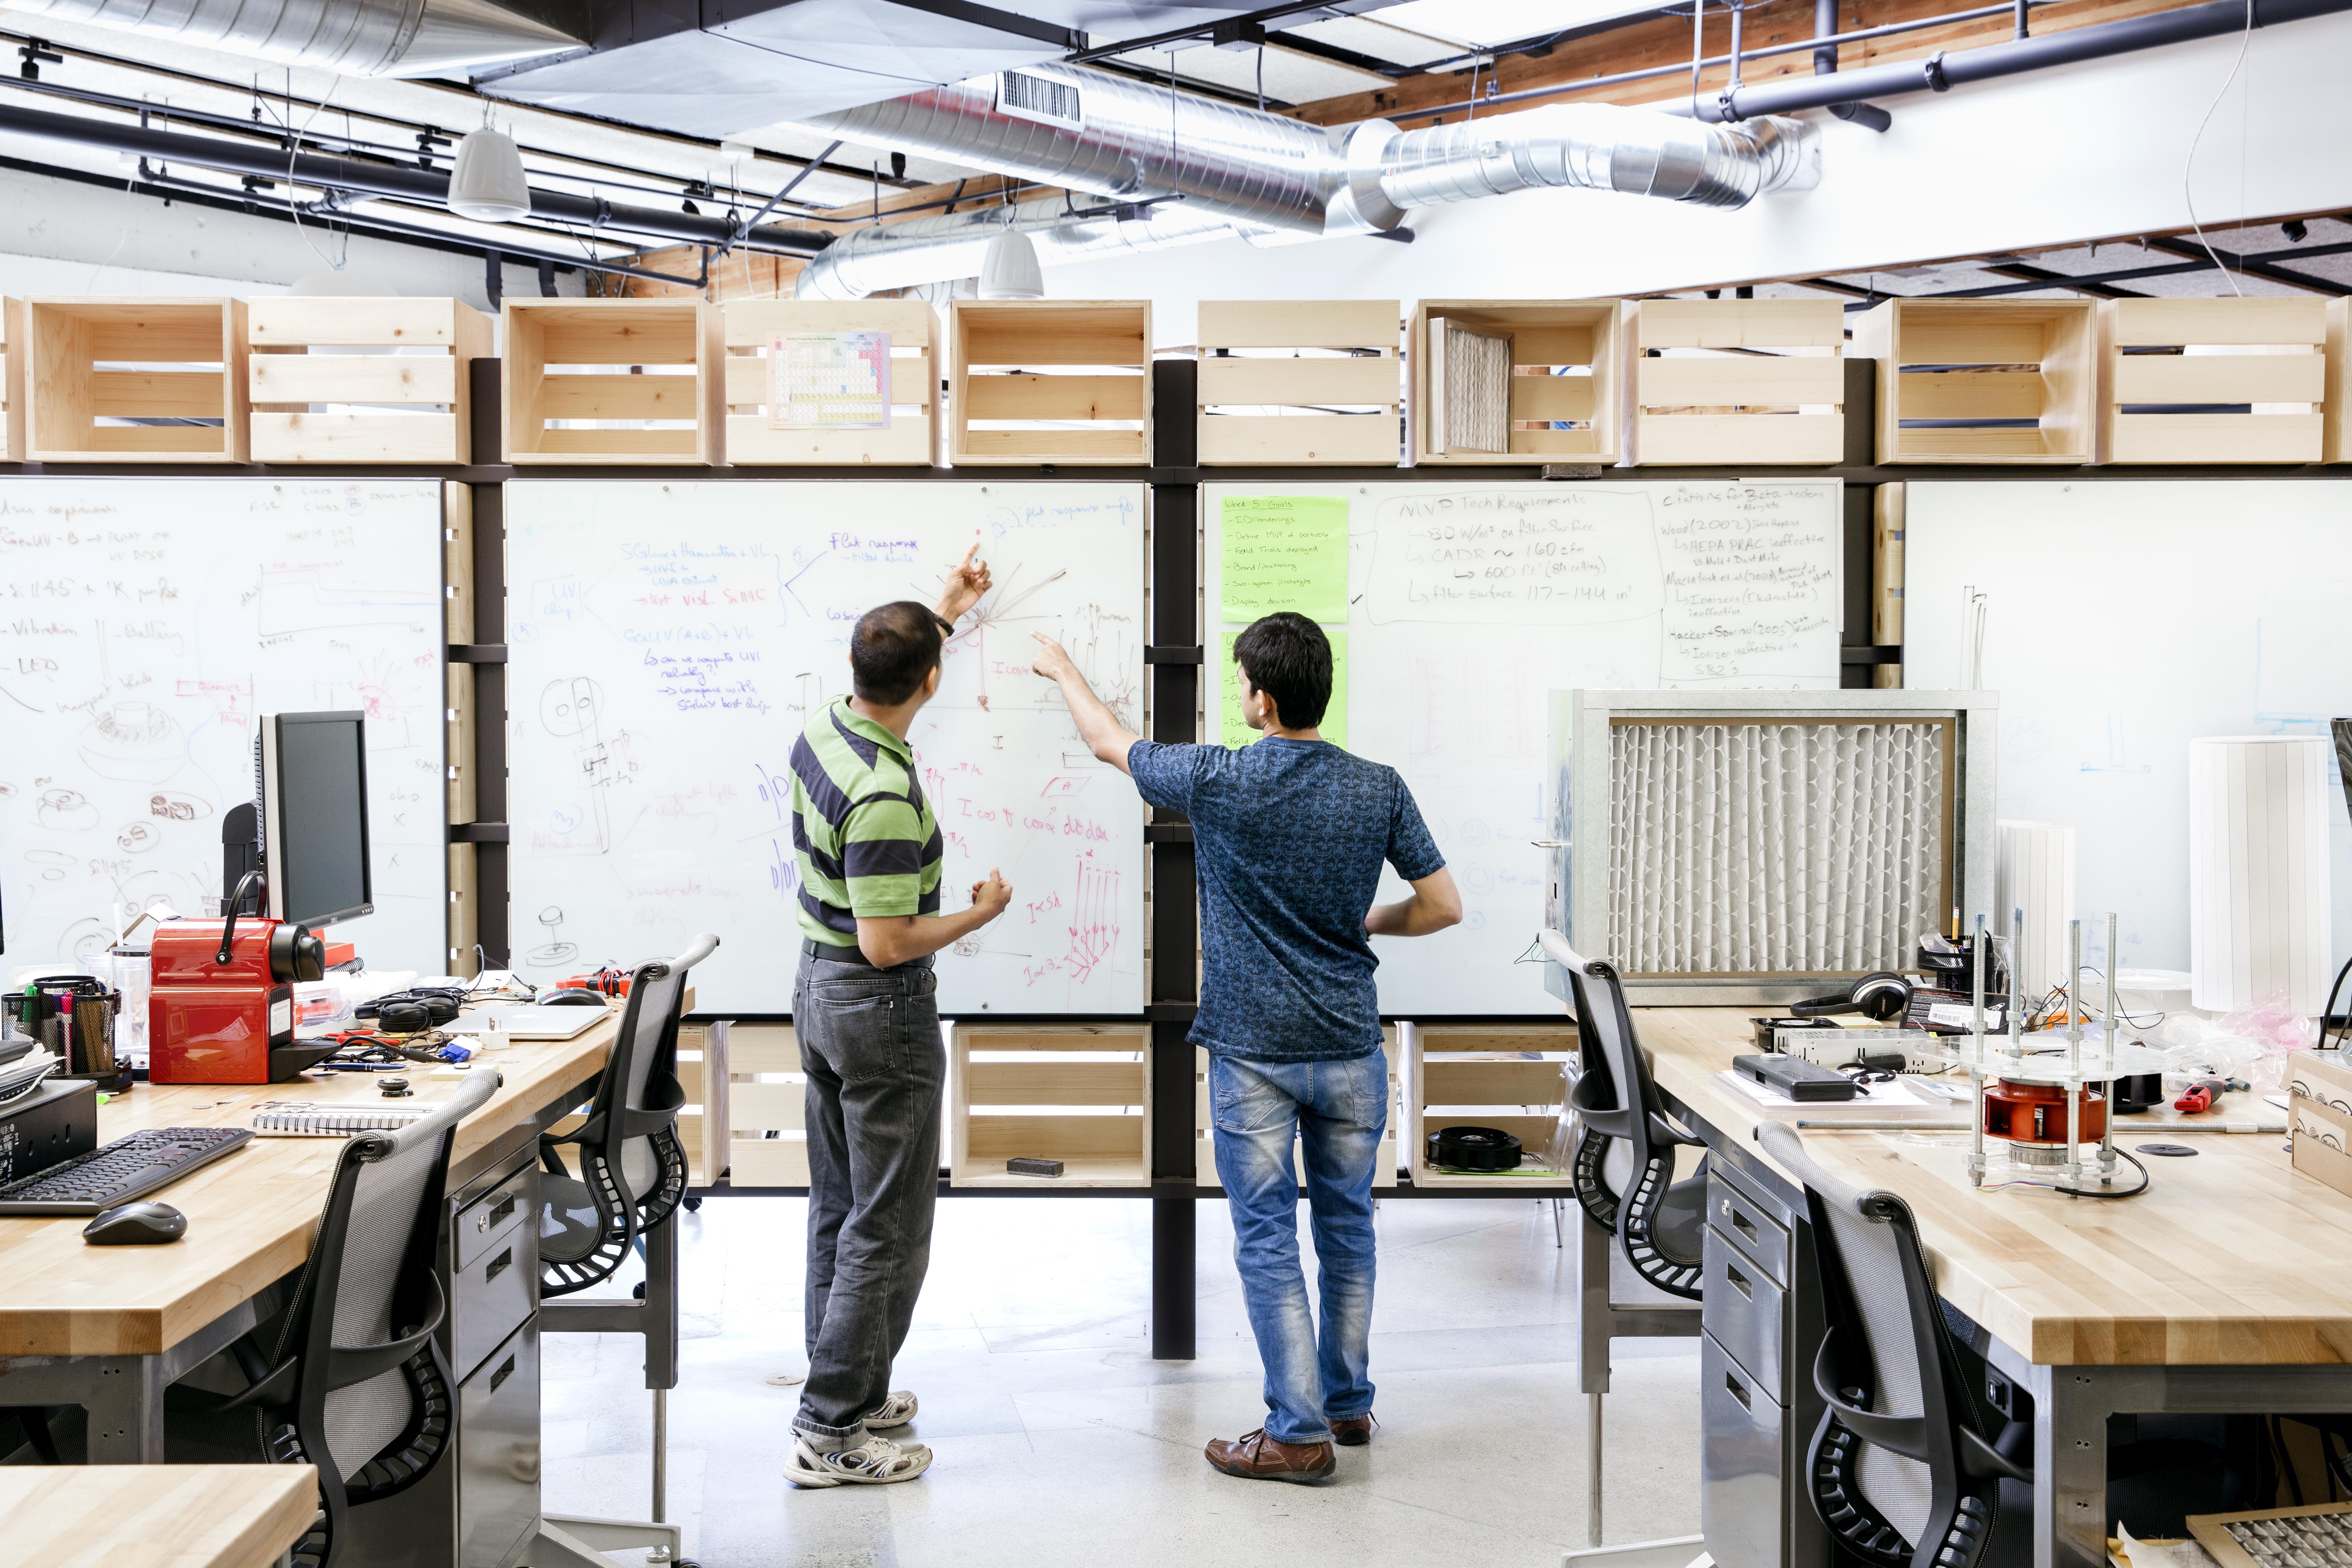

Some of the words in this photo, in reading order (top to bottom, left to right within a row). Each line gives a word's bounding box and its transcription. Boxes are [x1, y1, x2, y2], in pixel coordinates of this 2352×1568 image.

[1726, 487, 1744, 501] for
[1224, 500, 1246, 508] Week
[1252, 499, 1261, 509] 5
[1268, 500, 1293, 510] Goals
[1399, 498, 1453, 517] MVP
[1462, 496, 1494, 509] Tech
[1497, 493, 1586, 514] Requirements
[1234, 515, 1253, 524] ID
[1257, 516, 1295, 525] renderings
[1501, 529, 1514, 538] on
[1518, 518, 1547, 537] filter
[1661, 524, 1689, 536] Wood
[1286, 545, 1318, 555] deployed
[1689, 540, 1725, 554] HEPA
[1729, 538, 1766, 552] PRAC
[1769, 533, 1827, 548] ineffective
[1431, 548, 1485, 563] CADR
[1526, 542, 1557, 557] 160
[1705, 555, 1724, 566] Mold
[1734, 554, 1758, 565] Dust
[1758, 551, 1783, 563] Mite
[1485, 566, 1516, 579] 600
[1666, 571, 1717, 586] Macintosh
[1278, 579, 1312, 587] prototype
[1433, 585, 1465, 600] filter
[1469, 587, 1517, 600] surface
[1574, 586, 1606, 601] 144
[1689, 594, 1741, 606] Ionizers
[1231, 596, 1259, 608] Display
[1266, 597, 1296, 605] decision
[1689, 605, 1742, 618] ineffective
[1668, 626, 1705, 640] Hacker
[1691, 646, 1731, 660] Ionizer
[1734, 640, 1784, 656] ineffective
[18, 658, 59, 675] LED
[330, 916, 338, 924] DELL
